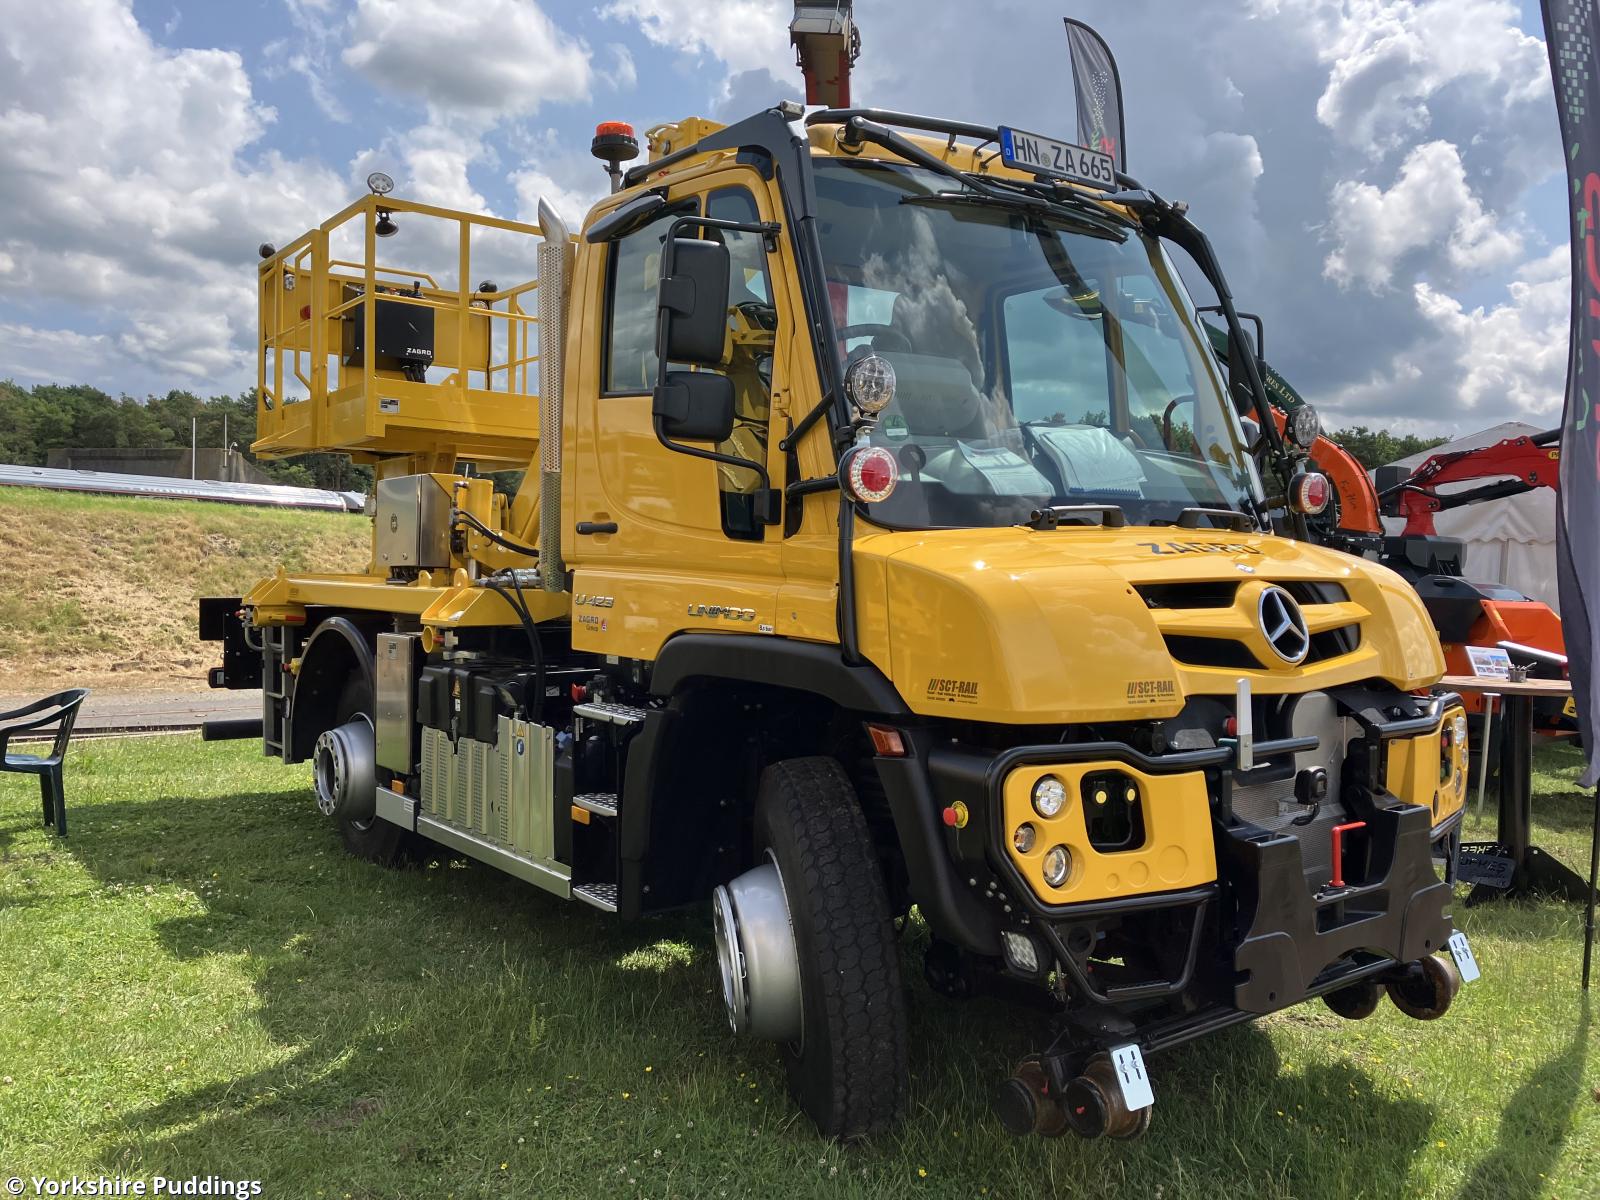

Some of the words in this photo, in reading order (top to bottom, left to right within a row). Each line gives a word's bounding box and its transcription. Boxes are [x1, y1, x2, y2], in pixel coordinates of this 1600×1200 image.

[1005, 147, 1011, 156] D
[1013, 134, 1040, 164] HN
[1051, 145, 1077, 173] ZA
[1080, 153, 1112, 182] 665
[406, 347, 432, 356] ZAGRO
[1136, 542, 1264, 555] ZAGRO
[687, 604, 757, 621] UNIMOG
